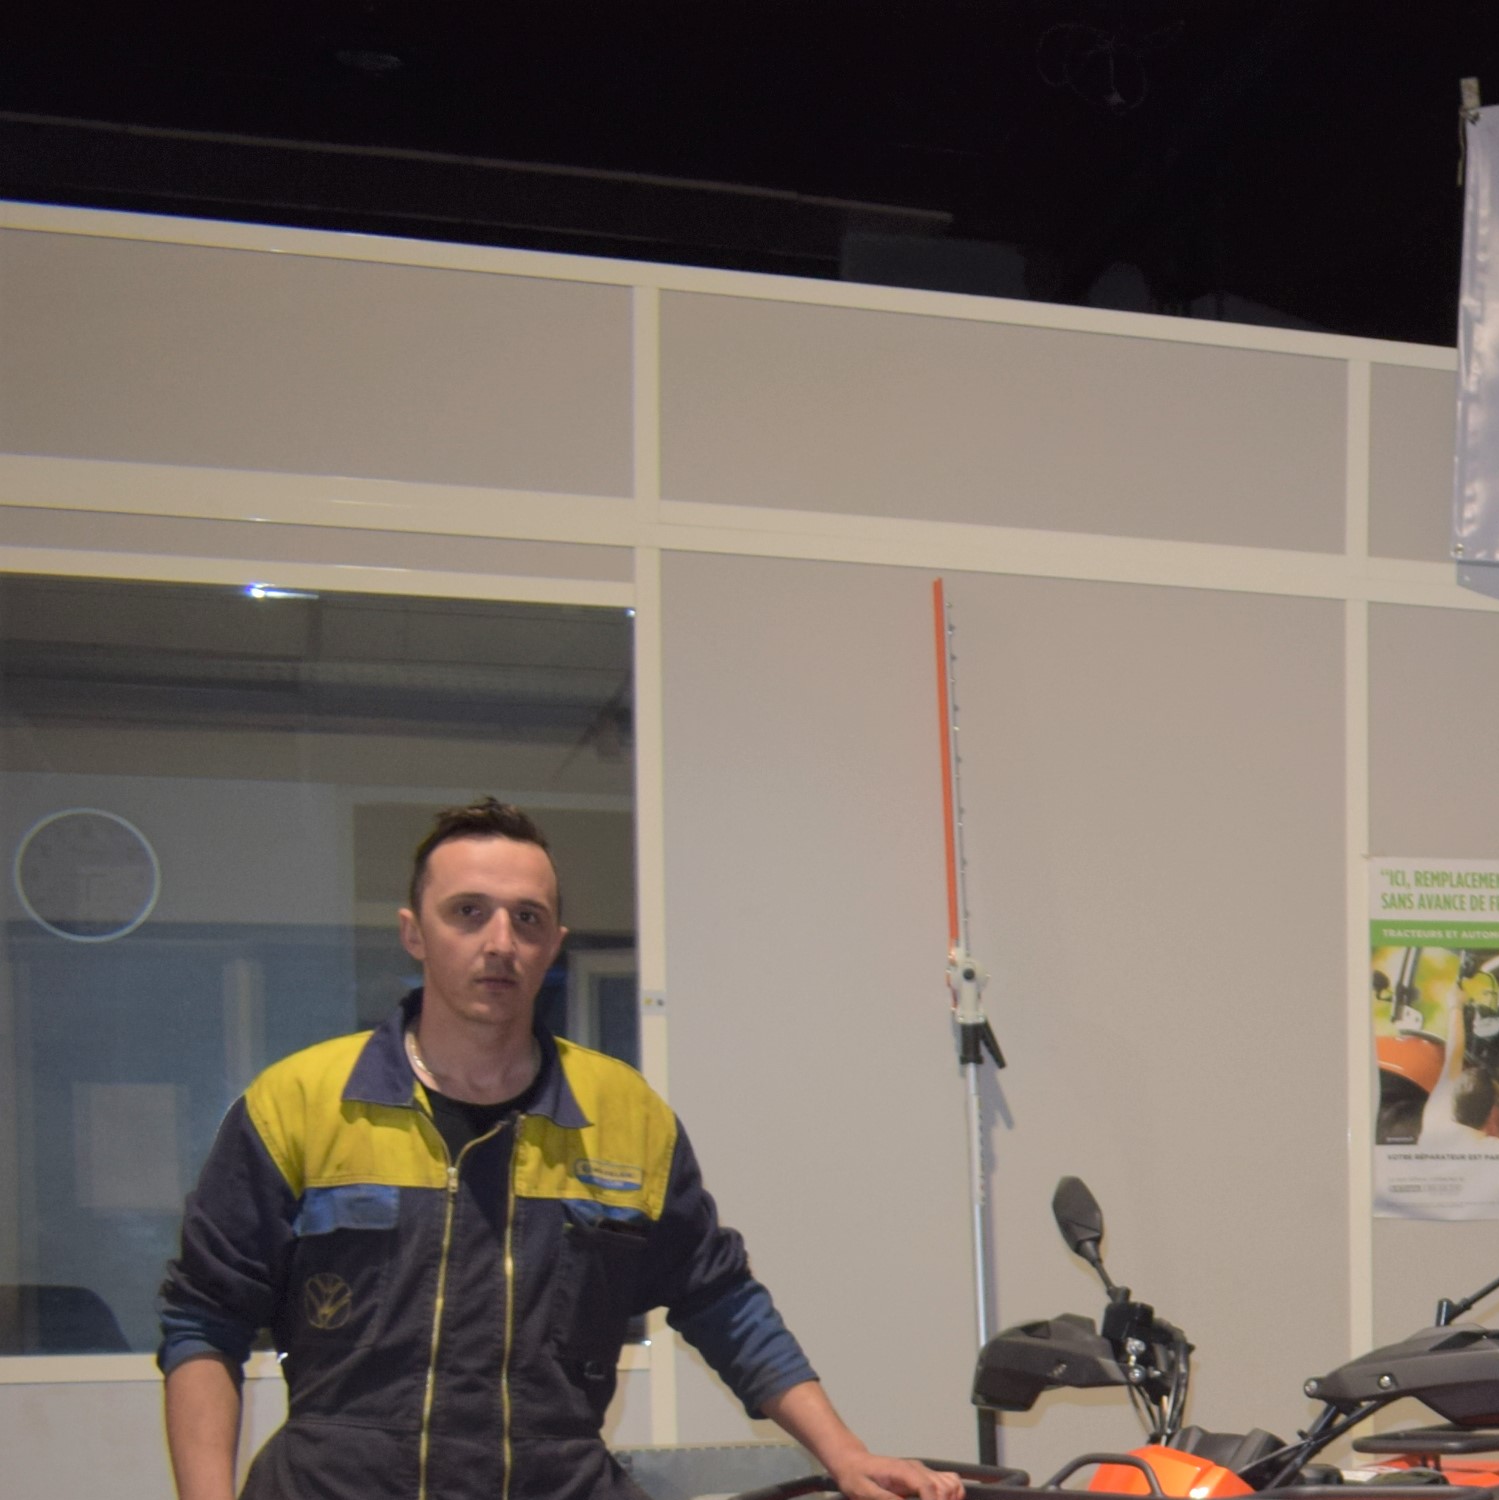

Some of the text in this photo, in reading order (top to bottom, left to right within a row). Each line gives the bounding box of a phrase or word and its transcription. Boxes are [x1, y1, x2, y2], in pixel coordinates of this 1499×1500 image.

[1381, 892, 1414, 910] SANS
[1417, 894, 1466, 911] AVANCE
[1469, 895, 1488, 911] DE
[1382, 928, 1443, 938] TRACTEURS
[1445, 930, 1458, 938] ET
